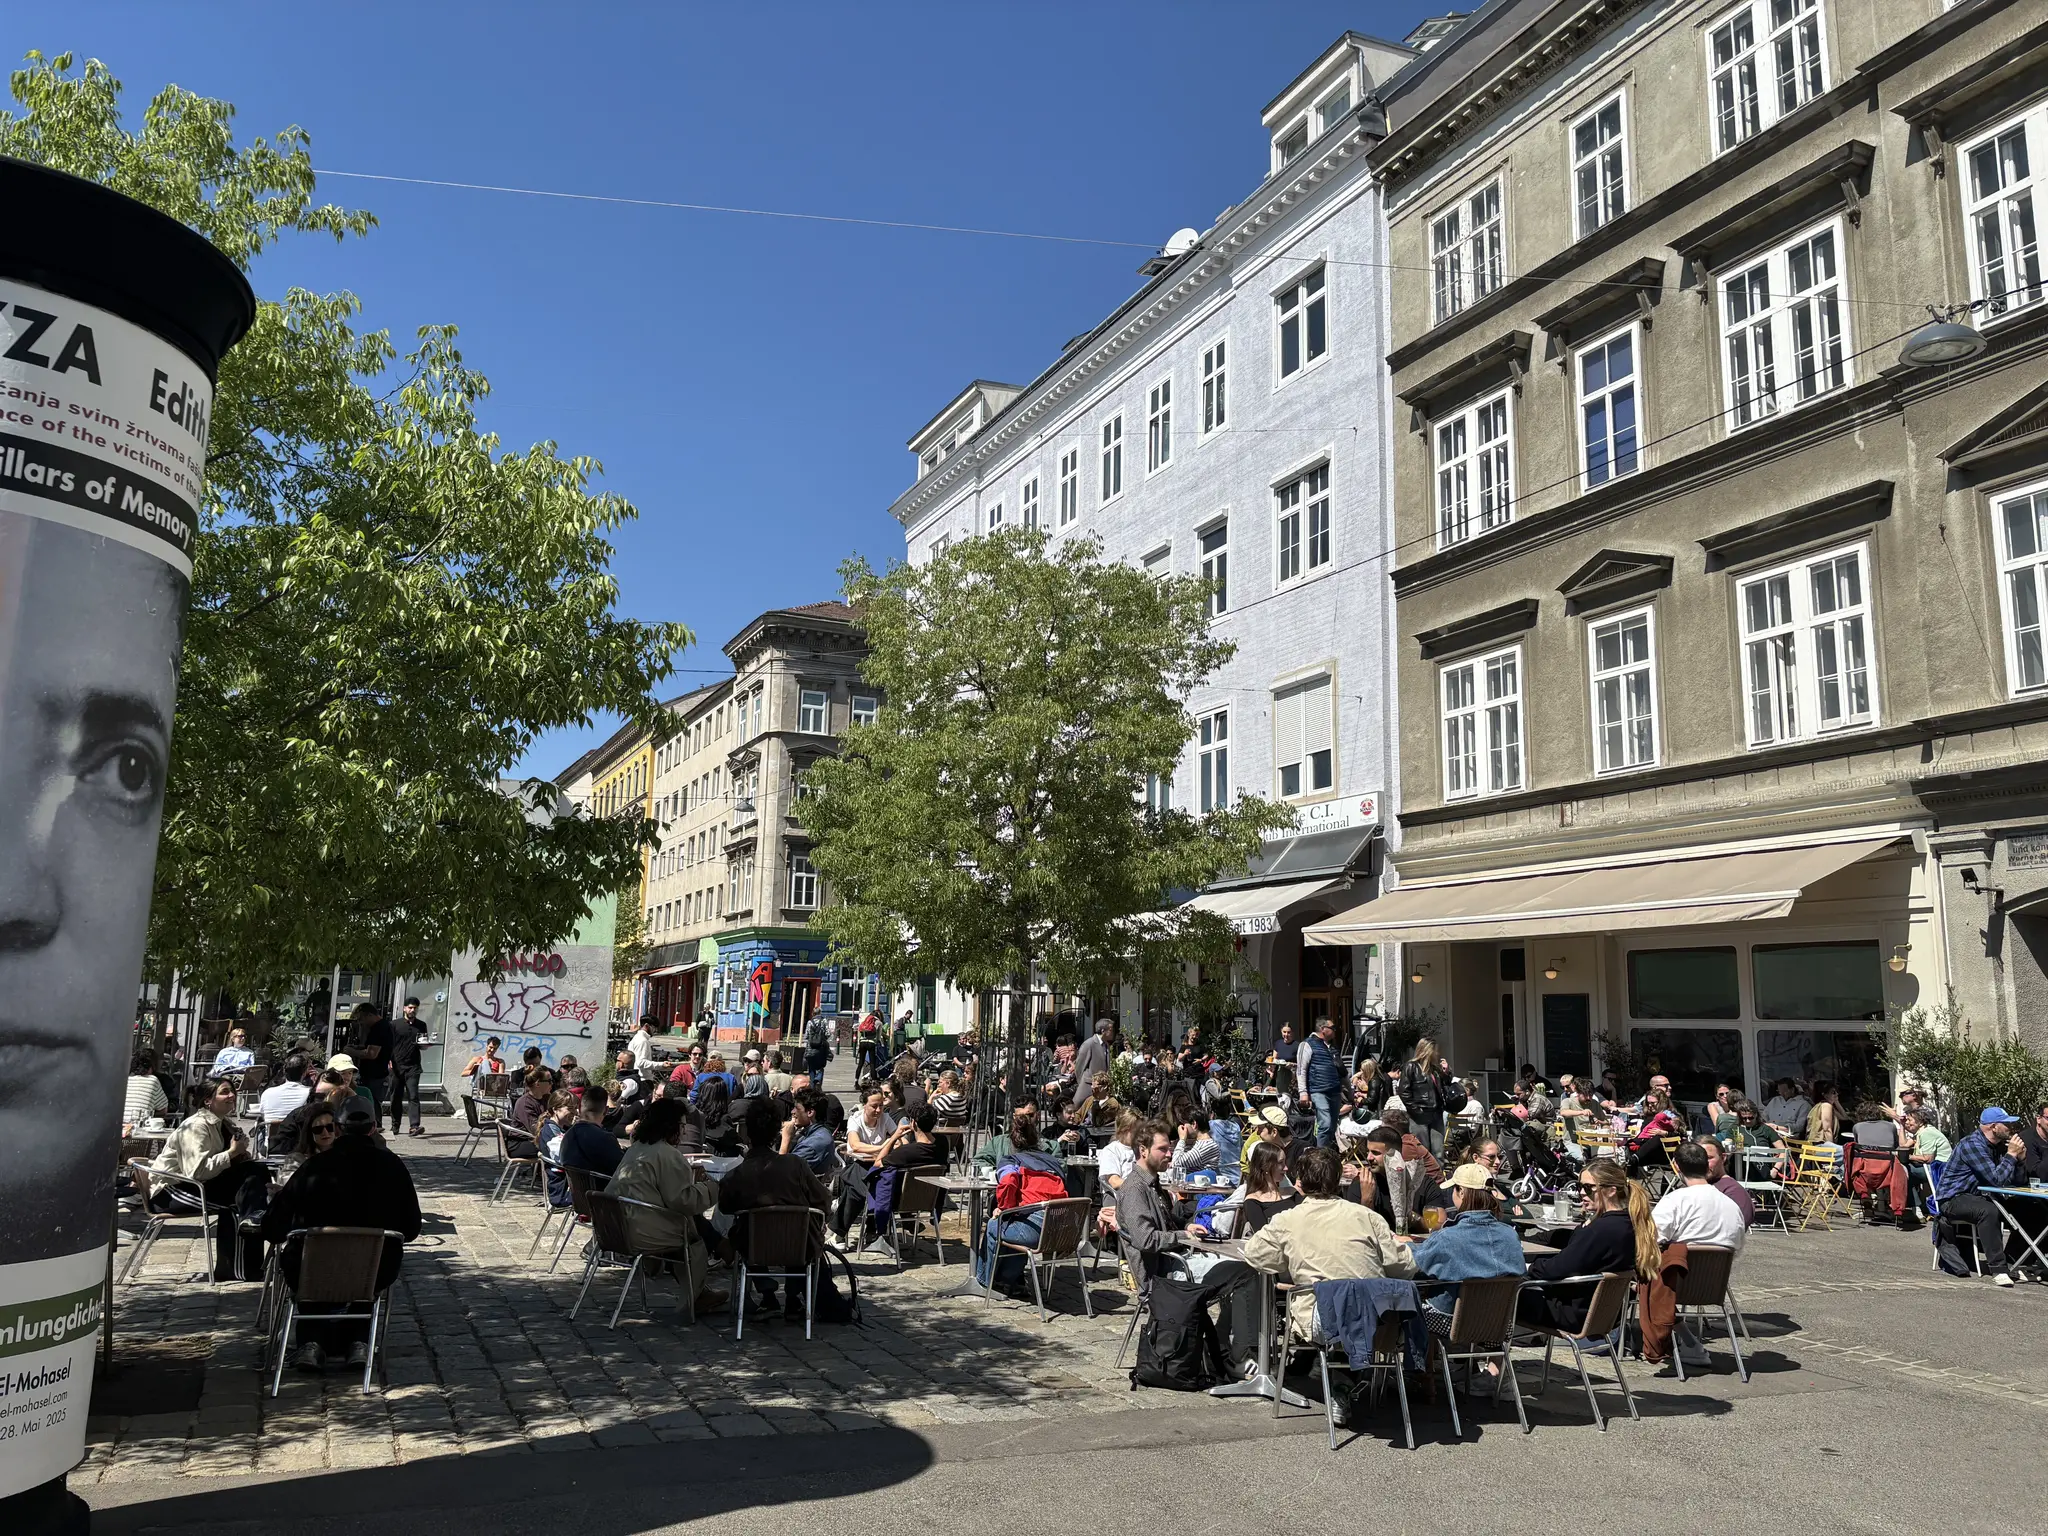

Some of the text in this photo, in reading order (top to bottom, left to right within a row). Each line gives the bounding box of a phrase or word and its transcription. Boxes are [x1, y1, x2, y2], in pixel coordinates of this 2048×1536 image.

[0, 301, 206, 448] ZA Edith
[68, 403, 119, 430] svim
[125, 420, 185, 463] žrtvama
[42, 420, 66, 434] of
[72, 425, 106, 448] the
[113, 441, 171, 477] victims
[174, 472, 185, 486] of
[186, 478, 197, 498] the
[85, 476, 116, 505] of
[120, 485, 191, 550] Memory
[1282, 815, 1350, 838] International
[1310, 804, 1334, 819] C.I.
[2013, 844, 2029, 853] und
[1249, 917, 1273, 933] 1983
[0, 1391, 68, 1418] el-mohasel.com
[0, 1407, 67, 1440] 28. Mai 2025
